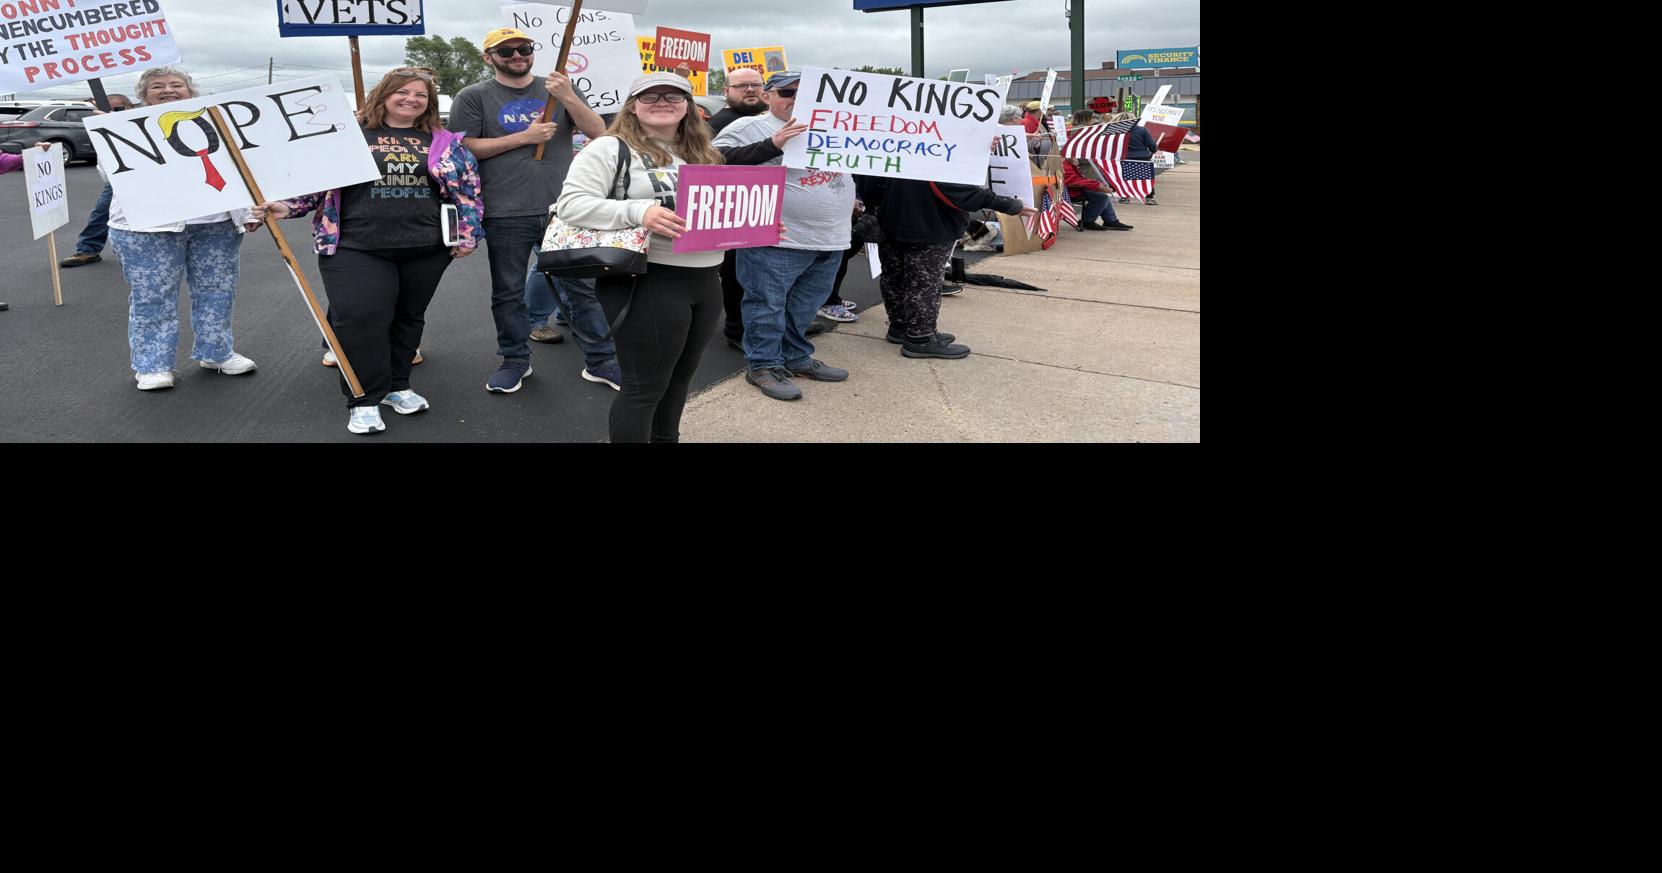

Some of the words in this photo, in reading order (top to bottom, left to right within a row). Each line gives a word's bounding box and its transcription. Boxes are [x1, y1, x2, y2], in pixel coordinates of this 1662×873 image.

[13, 38, 58, 61] THE
[64, 18, 167, 51] THOUGHT
[658, 35, 708, 63] FREEDOM
[23, 45, 153, 84] PROCESS
[733, 51, 753, 64] DEI
[1147, 51, 1194, 60] SECURITY
[816, 73, 868, 106] NO
[887, 76, 1000, 123] KINGS
[90, 84, 338, 175] NOPE
[503, 111, 539, 124] NAS
[809, 109, 943, 141] FREEDOM
[807, 132, 957, 162] DEMOCRACY
[37, 160, 52, 178] NO
[387, 162, 419, 174] MY
[805, 151, 902, 173] TRUTH
[374, 174, 429, 186] KINDA
[34, 183, 63, 208] KINGS
[370, 187, 431, 199] PEOPLE
[686, 184, 779, 231] FREEDOM
